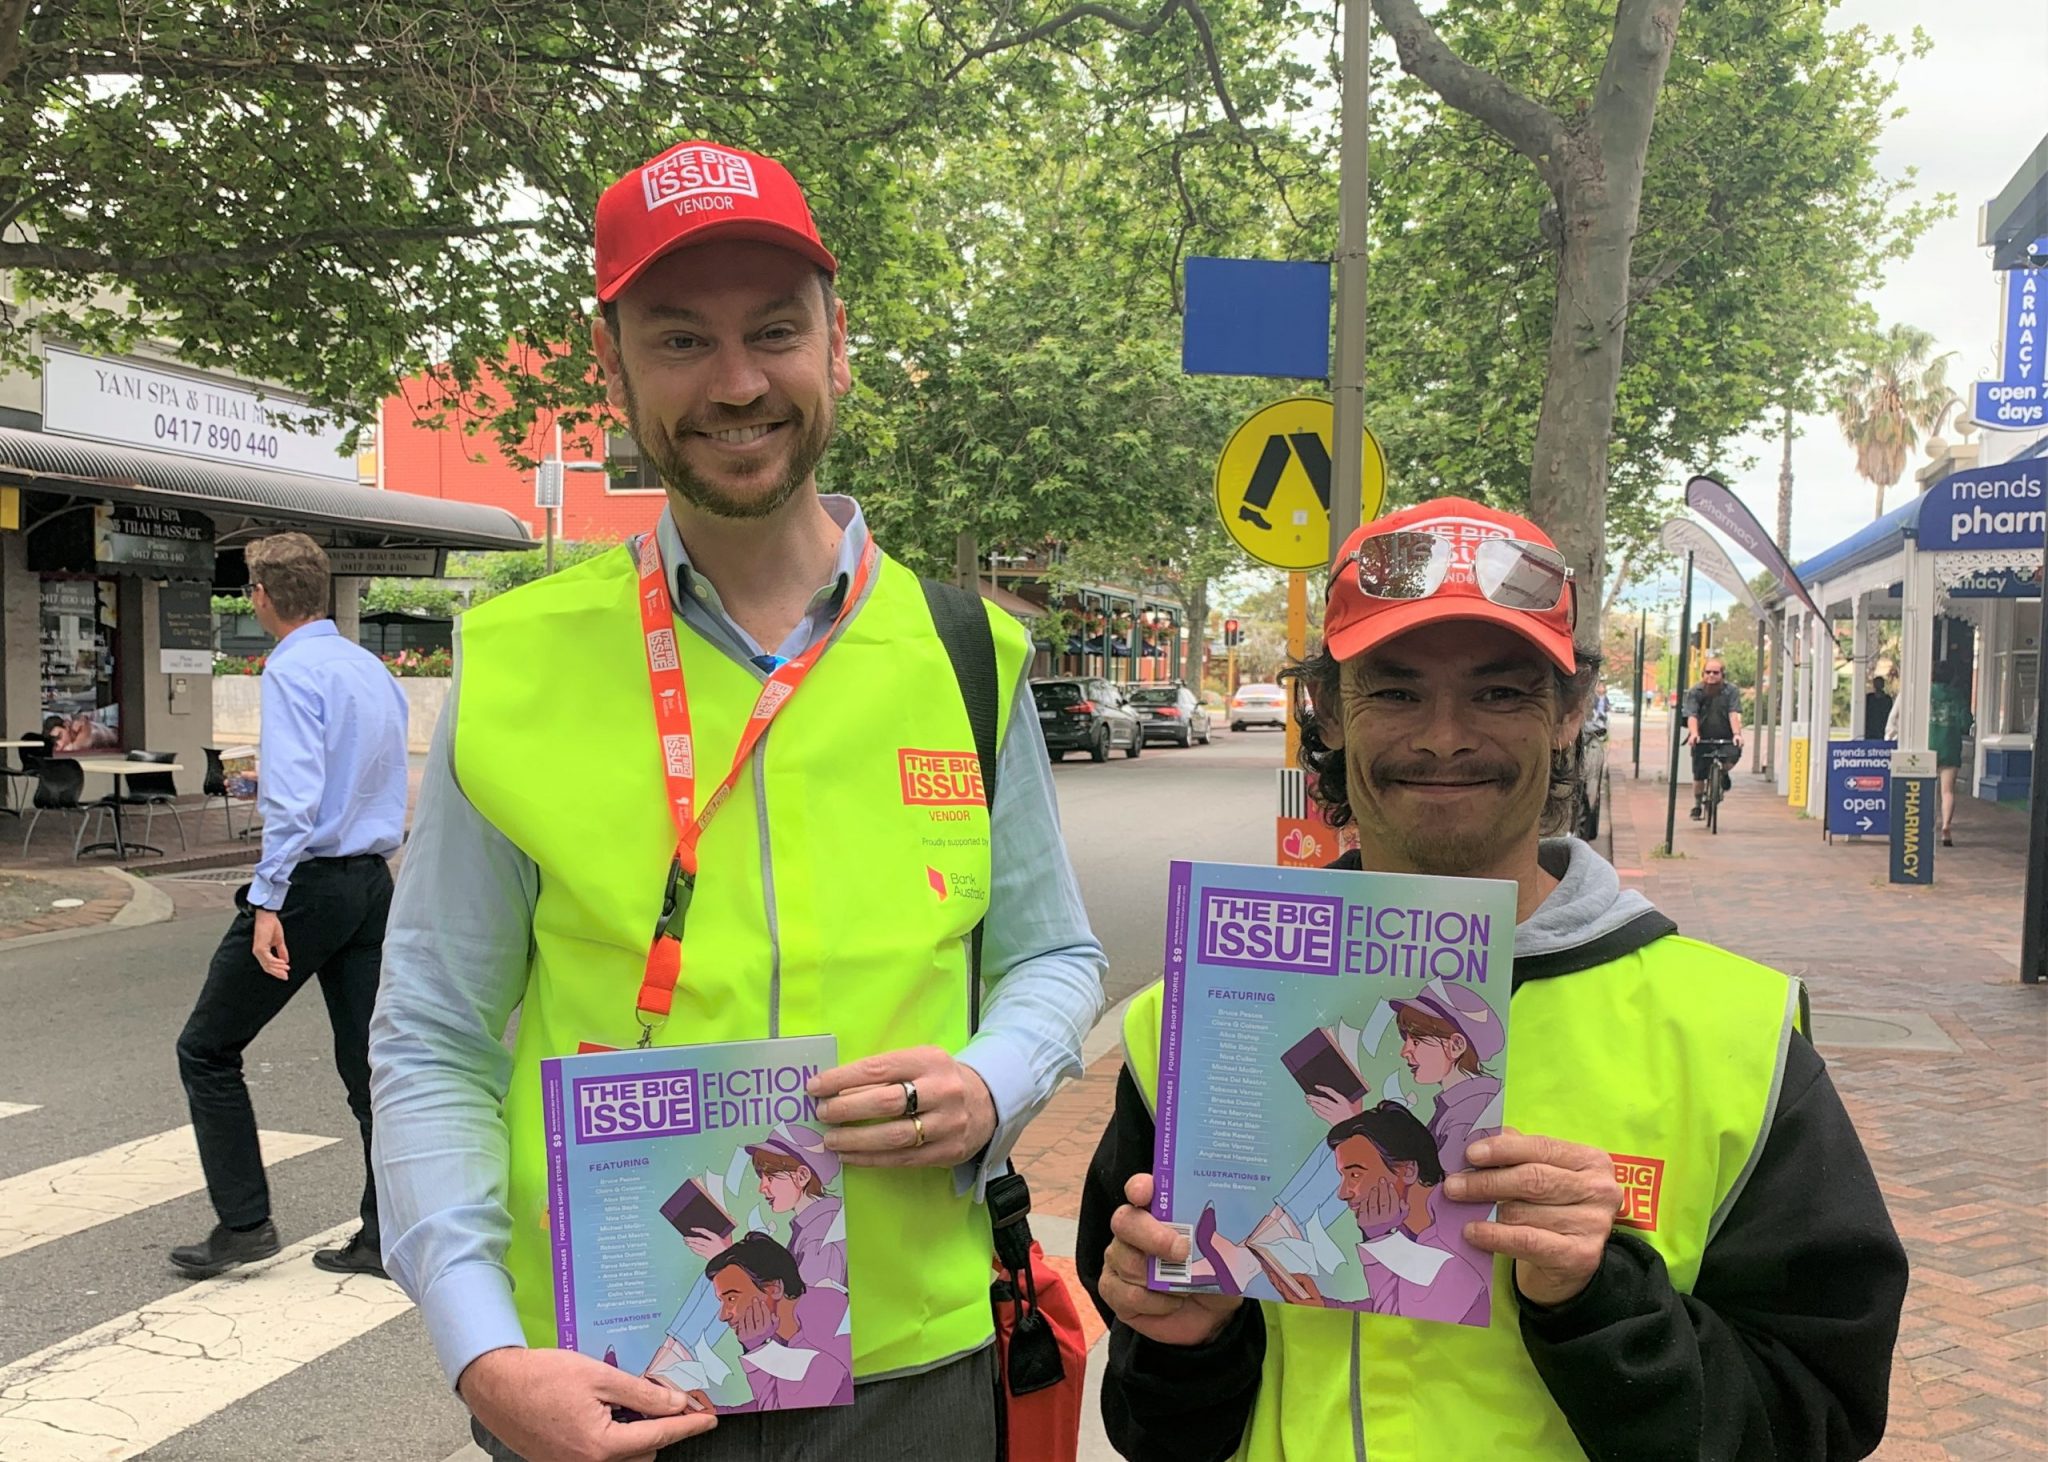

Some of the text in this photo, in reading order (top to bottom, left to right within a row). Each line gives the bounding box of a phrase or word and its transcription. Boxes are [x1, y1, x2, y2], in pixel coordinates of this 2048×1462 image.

[648, 151, 744, 177] THE BIG
[650, 162, 750, 201] ISSUE
[673, 195, 735, 217] VENDOR
[95, 369, 142, 401] YANI
[148, 381, 180, 408] SPA
[186, 389, 199, 411] &
[204, 392, 247, 422] THAI
[1988, 385, 2037, 404] open
[1997, 404, 2043, 424] days
[154, 413, 279, 460] 0417 890 440
[1951, 473, 2042, 500] mends
[135, 505, 181, 523] YANI SPA
[123, 519, 151, 536] THAI
[153, 523, 202, 541] MASSAGE
[650, 632, 668, 669] ISSUE
[665, 736, 683, 774] ISSUE
[907, 756, 980, 774] THE BIG
[1832, 748, 1866, 758] mends
[1793, 741, 1803, 802] DOCTORS
[908, 772, 986, 799] ISSUE
[928, 810, 971, 822] VENDOR
[1843, 798, 1886, 814] open
[1903, 780, 1921, 878] PHARMACY
[922, 837, 946, 848] Proudly
[947, 837, 981, 848] supported
[950, 872, 976, 885] Bank
[954, 885, 986, 901] Australia
[1211, 899, 1332, 927] THE BIG
[1347, 904, 1491, 947] FICTION
[1207, 920, 1330, 965] ISSUE
[1344, 940, 1489, 985] EDITION
[1207, 989, 1276, 1002] FEATURING
[1167, 947, 1182, 1071] FOURTEEN SHORT STORIES $9
[1211, 1063, 1237, 1071] Michael
[582, 1078, 690, 1104] THE BIG
[702, 1064, 819, 1100] FICTION
[583, 1096, 692, 1135] ISSUE
[703, 1095, 821, 1130] EDITION
[1164, 1106, 1172, 1131] EXTRA
[553, 1134, 563, 1148] $9
[1162, 1132, 1171, 1165] SIXTEEN
[588, 1157, 650, 1173] FEATURING
[1193, 1170, 1259, 1181] ILLUSTRATIONS
[1614, 1164, 1653, 1187] BIG
[1159, 1191, 1169, 1210] 621
[559, 1208, 567, 1241] FOURTEEN
[561, 1249, 569, 1270] PAGES
[562, 1271, 570, 1293] EXTRA
[563, 1293, 571, 1322] SIXTEEN
[593, 1312, 651, 1327] ILLUSTRATIONS
